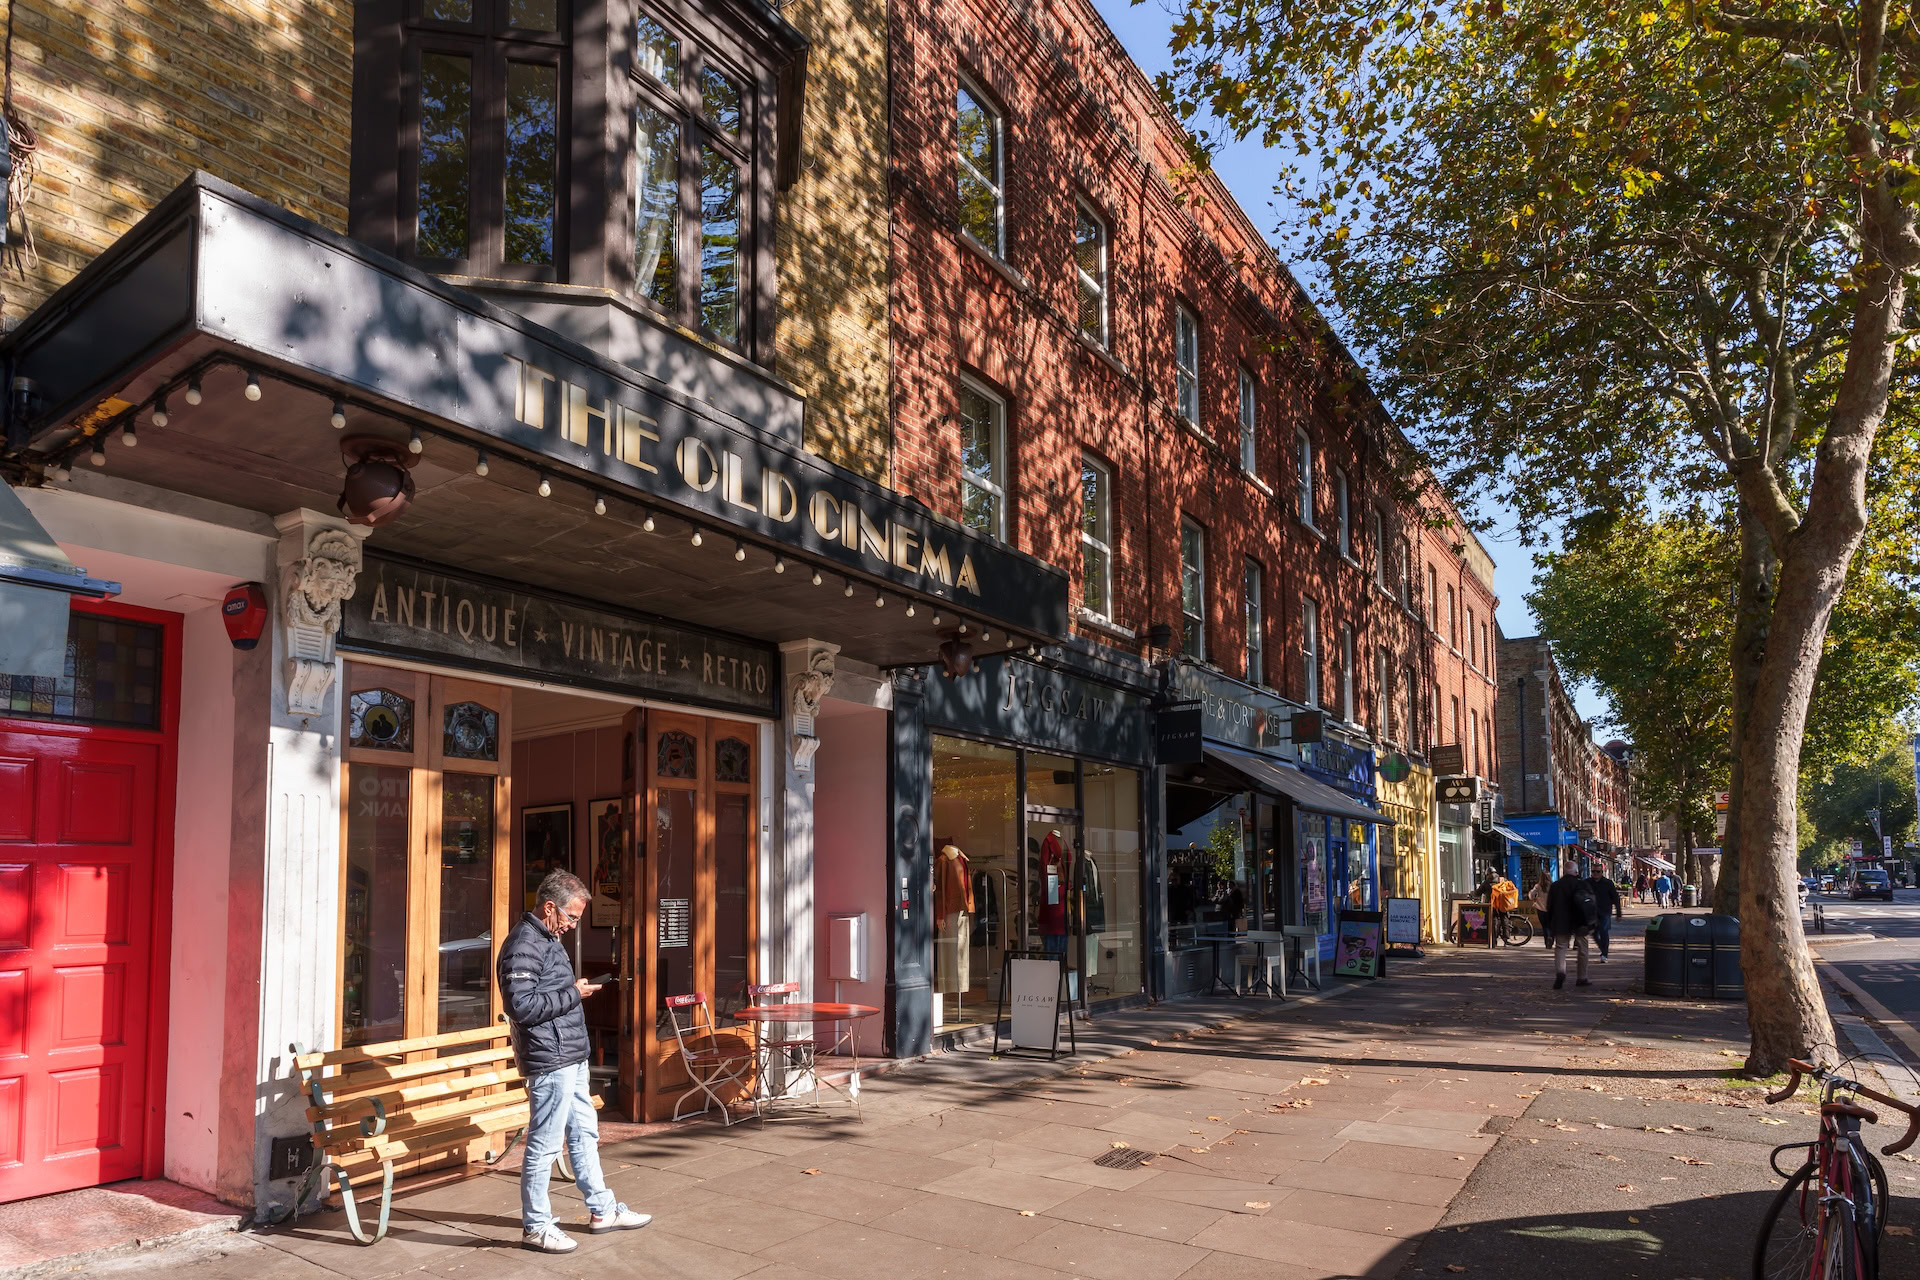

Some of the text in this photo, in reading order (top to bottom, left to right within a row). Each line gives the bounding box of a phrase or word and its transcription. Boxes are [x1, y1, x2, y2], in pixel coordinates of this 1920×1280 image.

[504, 352, 981, 597] THE OLD CINEMA
[370, 582, 767, 694] ANTIQUE VINTAGE RETRO
[1002, 674, 1108, 722] JIGSAW
[1226, 699, 1279, 737] TORTISE
[1161, 731, 1196, 742] JIGSAW
[1017, 994, 1055, 1003] JIGSAW
